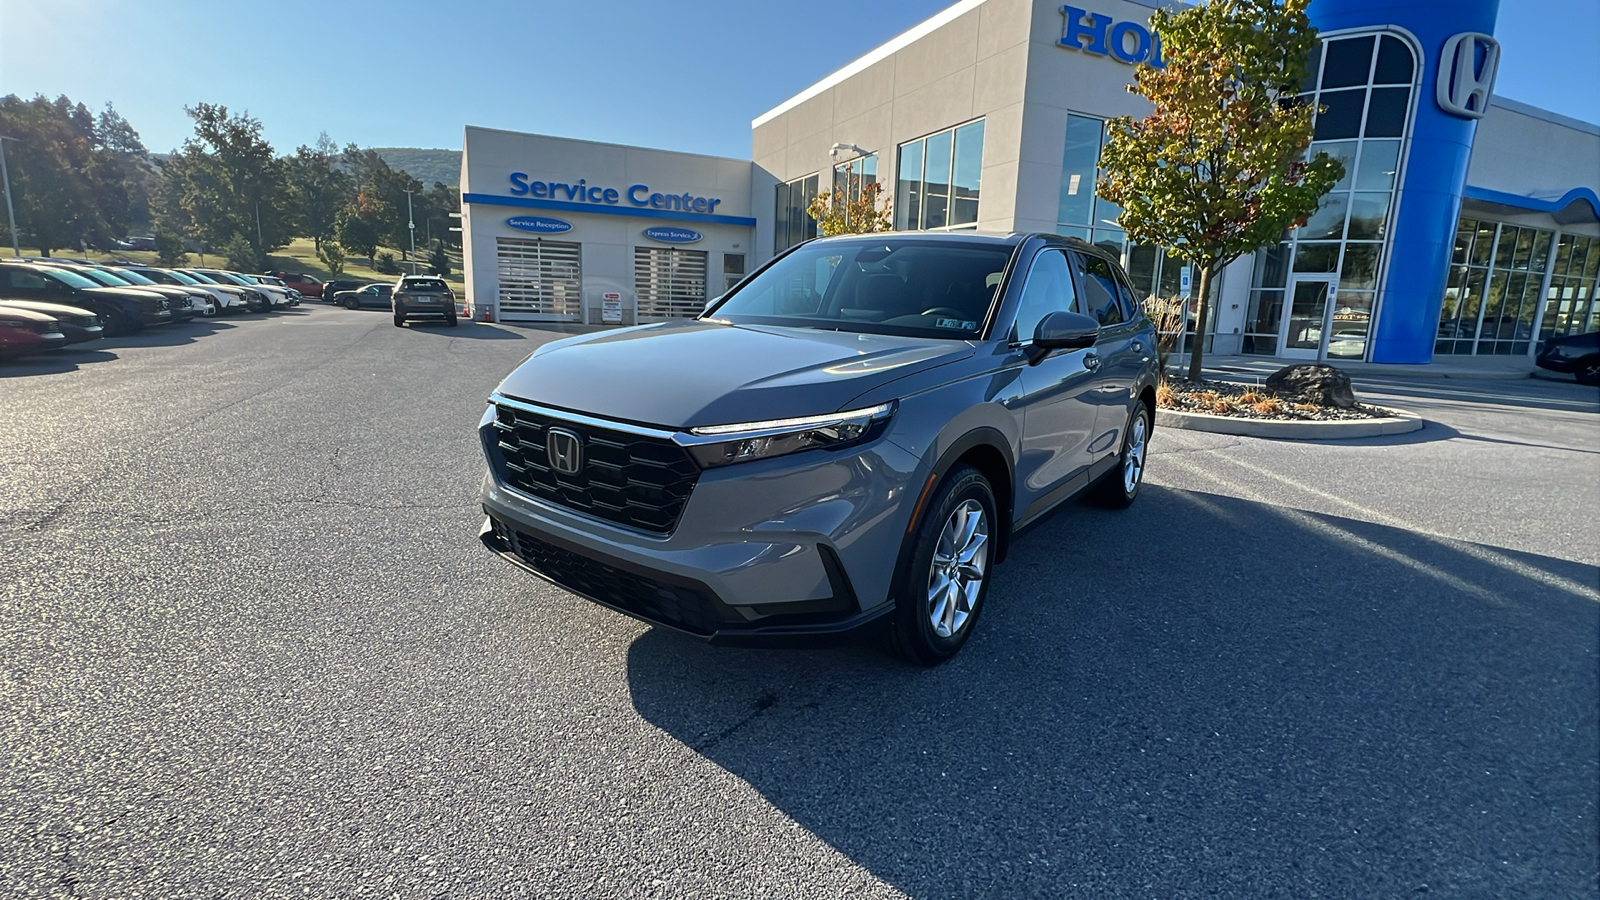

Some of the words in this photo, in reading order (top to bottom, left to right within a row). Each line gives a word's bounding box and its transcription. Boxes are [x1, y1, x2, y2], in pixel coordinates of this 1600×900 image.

[510, 171, 619, 204] Service
[627, 184, 721, 213] Center
[509, 219, 535, 227] Service
[536, 221, 569, 229] Reception
